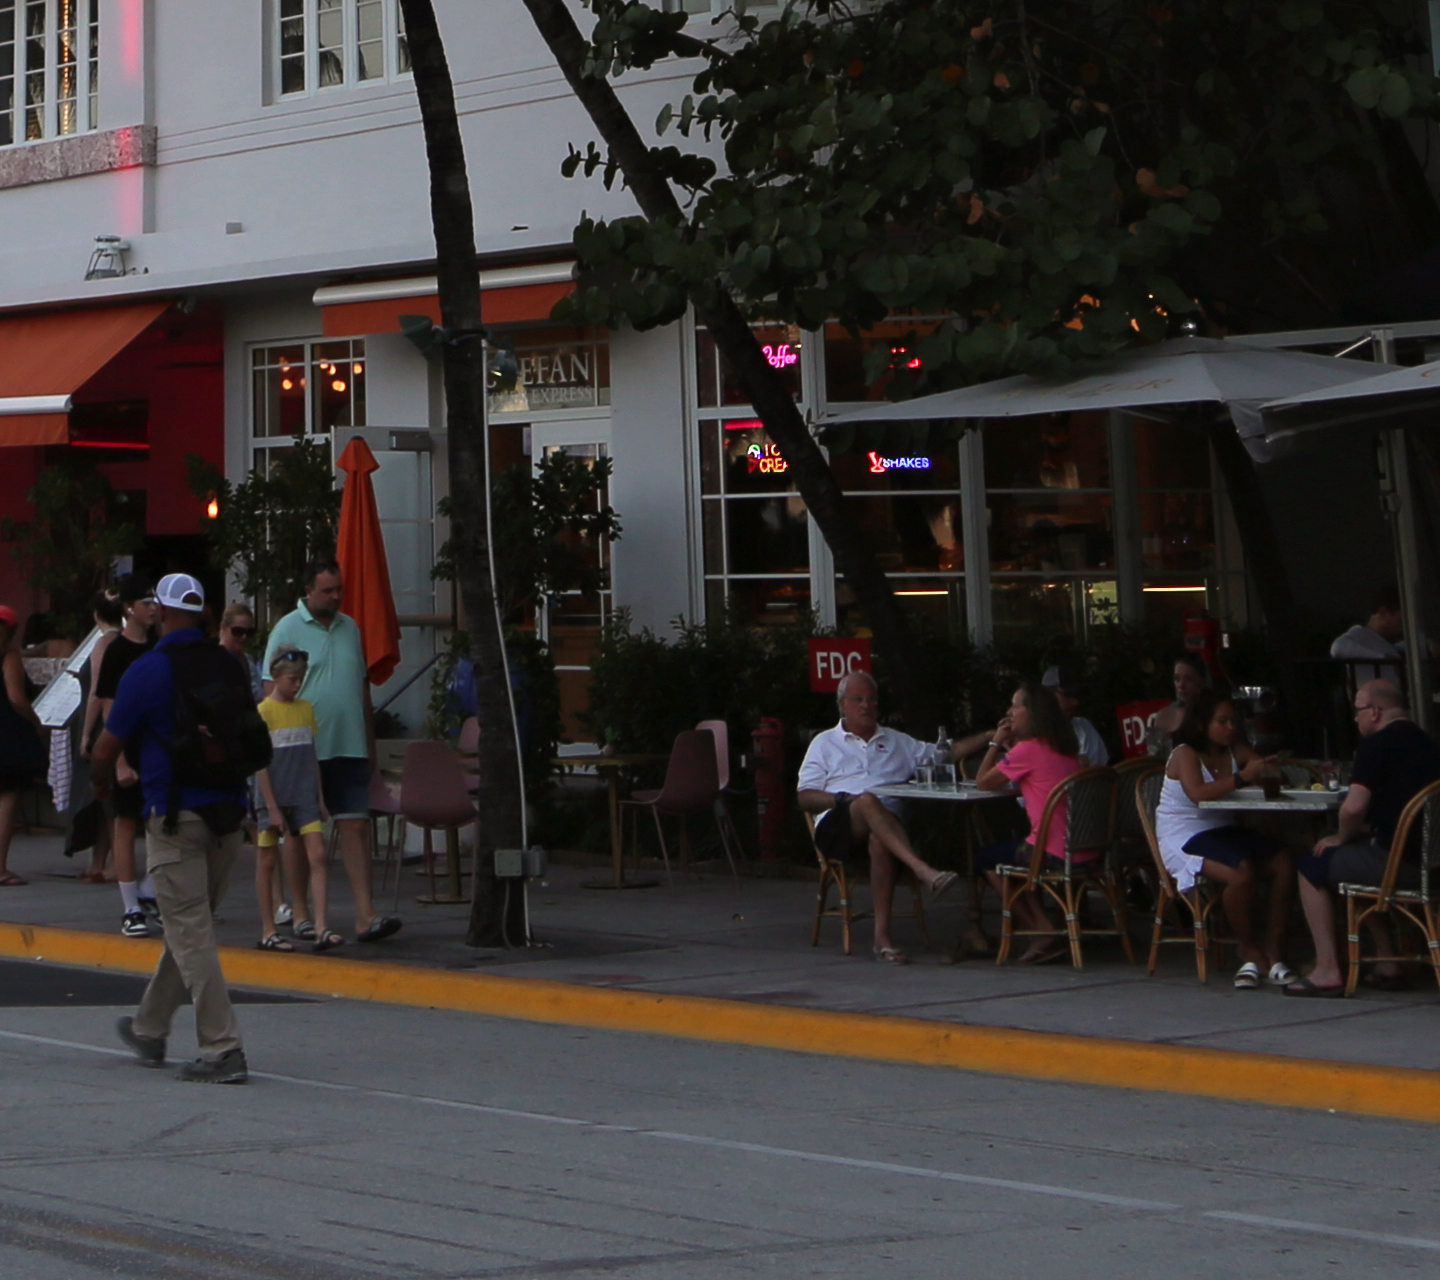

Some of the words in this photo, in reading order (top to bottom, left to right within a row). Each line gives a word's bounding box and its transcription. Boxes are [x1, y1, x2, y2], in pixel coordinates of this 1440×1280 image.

[531, 385, 593, 404] EXPRESS
[882, 456, 929, 469] SHAKES
[816, 651, 862, 679] FDC
